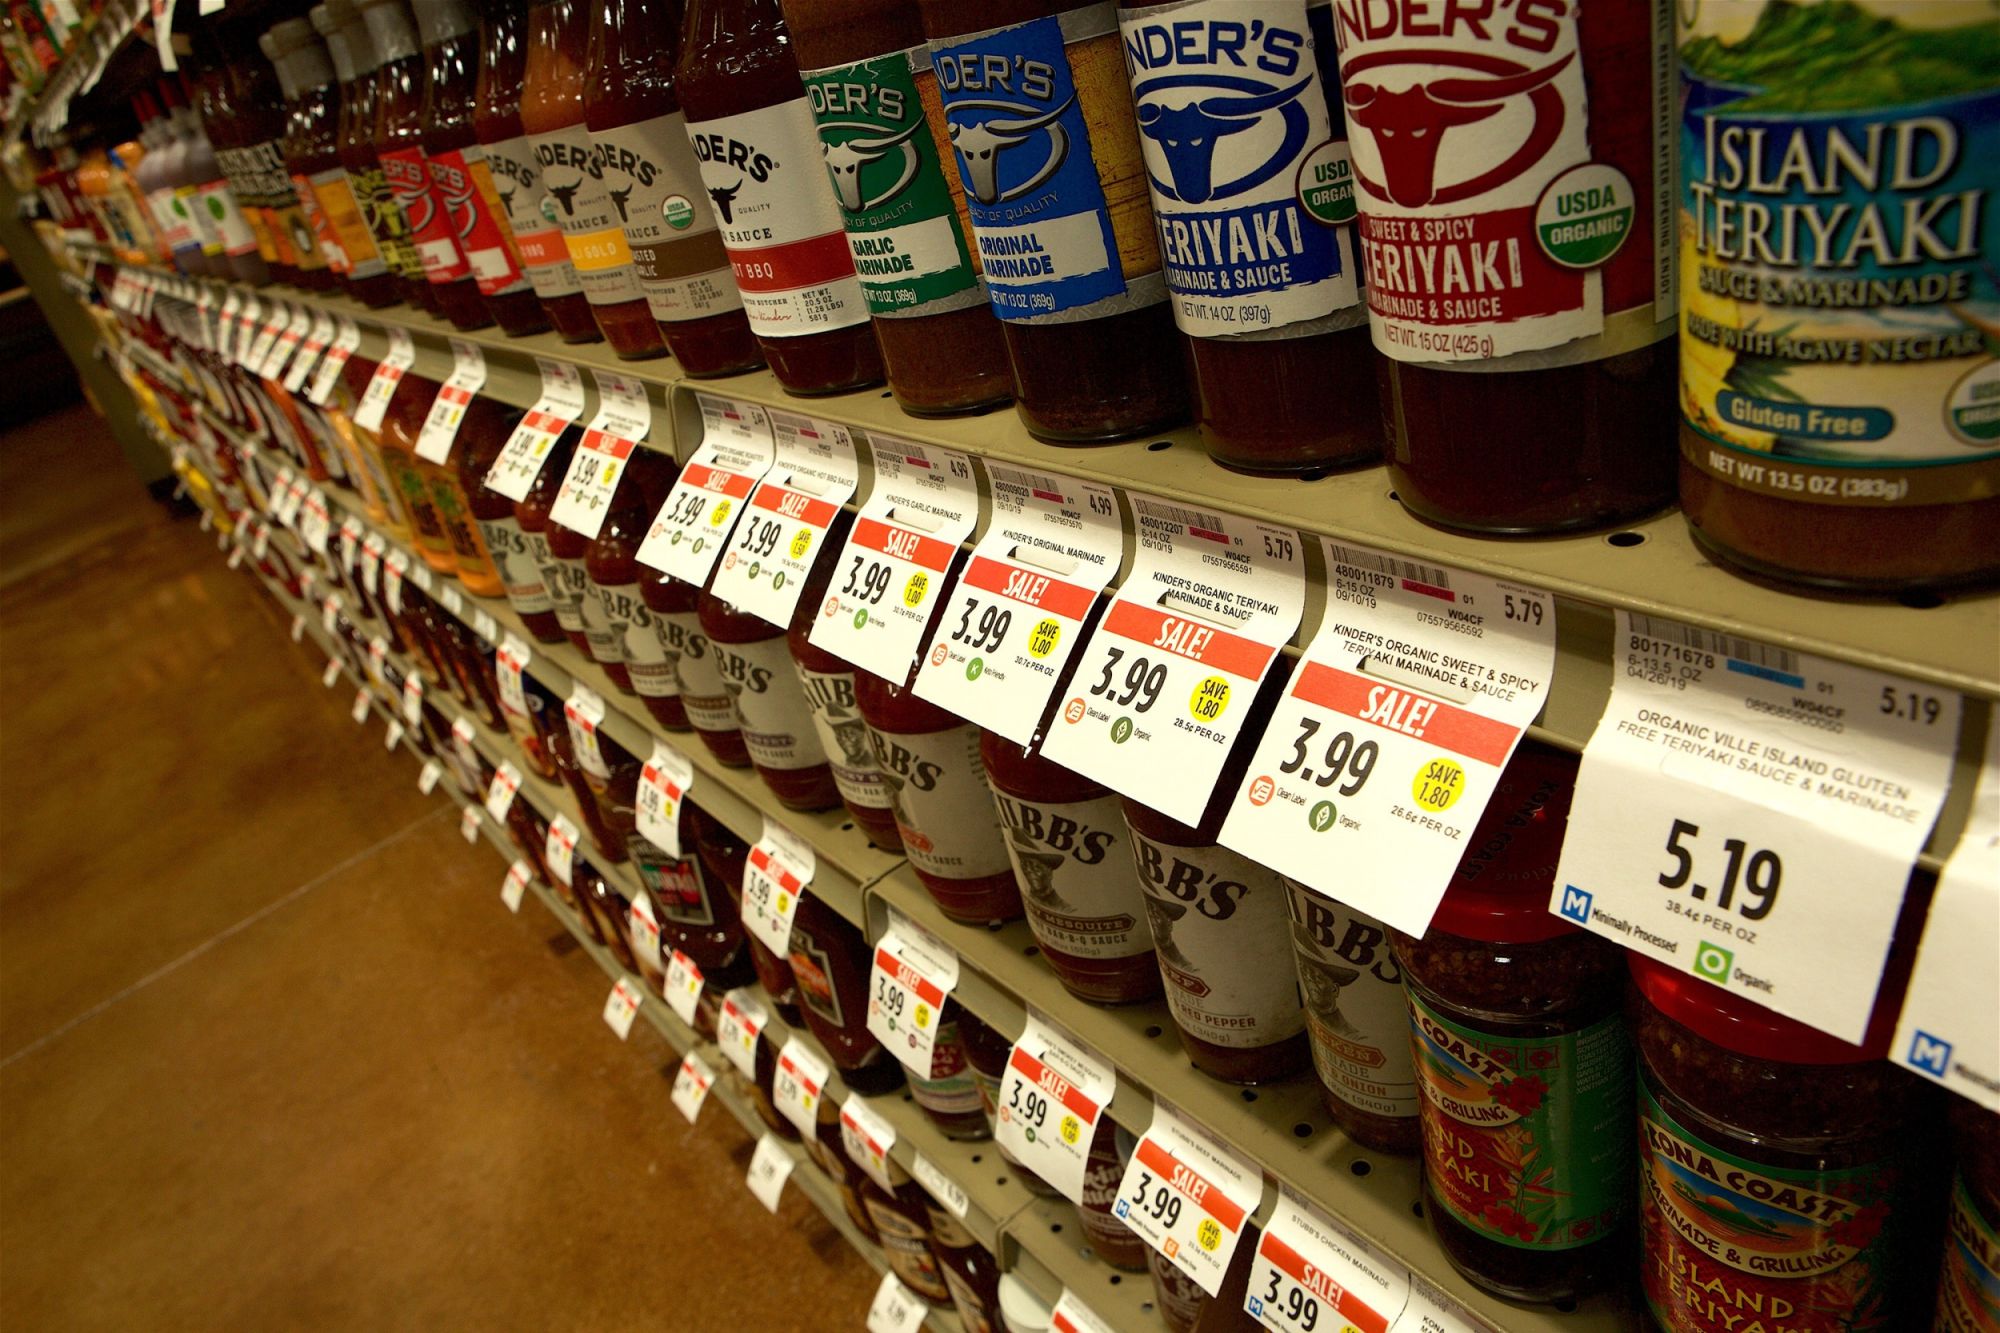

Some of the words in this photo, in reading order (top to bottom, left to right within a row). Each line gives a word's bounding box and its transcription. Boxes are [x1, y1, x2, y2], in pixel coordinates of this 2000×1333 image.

[1334, 0, 1568, 56] NDER'S
[1124, 20, 1305, 78] NDER'S
[808, 83, 905, 121] DER'S
[1703, 114, 1959, 195] ISLAND
[870, 201, 915, 227] QUALITY
[1006, 191, 1060, 222] QUALITY
[1556, 184, 1617, 216] USDA
[729, 228, 774, 243] SAUCE
[1369, 219, 1407, 242] SWEET
[1411, 220, 1420, 241] &
[1424, 218, 1474, 241] SPICY
[1551, 214, 1625, 246] ORGANIC
[1690, 182, 1987, 270] TERIYAKI
[853, 237, 896, 257] GARLIC
[980, 234, 1044, 256] ORIGINAL
[747, 262, 775, 280] BBQ
[983, 256, 1055, 279] MARINADE
[1221, 271, 1231, 290] &
[1236, 263, 1292, 288] SAUCE
[1361, 237, 1523, 295] TERIYAKI
[1699, 261, 1759, 302] SAUCE
[1786, 270, 1972, 308] MARINADE
[1239, 304, 1272, 324] (397g)
[1371, 297, 1425, 320] MARINADE
[1429, 300, 1439, 319] &
[1443, 296, 1503, 319] SAUCE
[1430, 333, 1451, 352] OZ
[1722, 323, 1774, 357] WITH
[1776, 331, 1860, 363] AGAVE
[1866, 329, 1986, 363] NECTAR
[1730, 396, 1801, 432] Gluten
[1807, 409, 1869, 437] Free
[703, 471, 731, 493] SALE!
[1709, 450, 1737, 477] NET
[1737, 462, 1766, 485] WT
[1769, 469, 1804, 492] 13.5
[1808, 474, 1838, 497] OZ
[1842, 476, 1908, 501] (383g)
[667, 492, 707, 528] 3.99
[776, 492, 810, 518] SALE!
[1089, 494, 1112, 518] 4.99
[740, 516, 782, 558] 3.99
[1140, 516, 1184, 536] 480012207
[883, 529, 921, 560] SALE!
[1002, 529, 1032, 546] KINDER'S
[1033, 538, 1065, 556] ORIGINAL
[1066, 547, 1106, 567] MARINADE
[1264, 535, 1293, 562] 5.79
[842, 555, 892, 605] 3.99
[910, 574, 928, 591] SAVE
[1002, 569, 1050, 605] SALE!
[1335, 563, 1394, 590] 480011879
[1359, 583, 1375, 598] OZ
[906, 588, 922, 605] 1.00
[1152, 570, 1192, 591] KINDER'S
[1193, 581, 1234, 604] ORGANIC
[1236, 593, 1279, 616] TERIYAKI
[1167, 588, 1214, 612] MARINADE
[1221, 604, 1254, 622] SAUCE
[1335, 592, 1378, 610] 09/10/19
[952, 597, 1012, 654] 3.99
[1416, 611, 1484, 639] 075579565592
[1448, 608, 1485, 626] W04CF
[1504, 595, 1544, 627] 5.79
[1031, 636, 1052, 656] 1.00
[1037, 621, 1059, 640] SAVE
[1154, 617, 1215, 661] SALE!
[1333, 622, 1384, 649] KINDER'S
[1385, 638, 1439, 666] ORGANIC
[1441, 655, 1484, 681] SWEET
[1488, 668, 1496, 681] &
[1500, 670, 1539, 694] SPICY
[1629, 636, 1715, 669] 80171678
[1090, 646, 1168, 713] 3.99
[1342, 640, 1395, 667] TERIYAKI
[1395, 657, 1460, 687] MARINADE
[1460, 676, 1469, 689] &
[1472, 679, 1516, 703] SAUCE
[1627, 668, 1687, 691] 04/26/19
[1628, 654, 1673, 675] 6-13.5
[1679, 666, 1702, 684] OZ
[1201, 679, 1229, 701] SAVE
[1195, 696, 1220, 719] 1.80
[1359, 685, 1439, 739] SALE!
[1879, 687, 1941, 727] 5.19
[1173, 717, 1194, 732] 28.5¢
[1194, 725, 1212, 740] PER
[1279, 717, 1379, 798] 3.99
[1637, 709, 1709, 741] ORGANIC
[1713, 730, 1760, 756] VILLE
[1761, 743, 1830, 777] ISLAND
[1831, 766, 1911, 802] GLUTEN
[1425, 761, 1461, 789] SAVE
[1617, 720, 1659, 746] FREE
[1661, 732, 1735, 769] TERIYAKI
[1736, 757, 1798, 787] SAUCE
[1800, 776, 1812, 791] &
[1818, 781, 1920, 824] MARINADE
[1417, 780, 1450, 809] 1.80
[1391, 804, 1418, 825] 26.6¢
[1419, 816, 1443, 835] PER
[1444, 825, 1461, 841] OZ
[1658, 818, 1783, 921] 5.19
[1046, 914, 1124, 931] MESQUITE
[1591, 907, 1633, 938] Minimally
[1633, 924, 1677, 953] Processed
[1665, 898, 1701, 924] 38.4¢
[1702, 911, 1734, 935] PER
[1735, 925, 1757, 945] OZ
[1091, 933, 1128, 946] SAUCE
[878, 977, 905, 1017] 3.99
[1733, 967, 1776, 995] Organic
[1205, 1014, 1256, 1028] PEPPER
[1422, 1017, 1505, 1080] COAST
[1037, 1067, 1069, 1102] SALE!
[1342, 1075, 1387, 1096] ONION
[1009, 1079, 1047, 1127] 3.99
[1442, 1097, 1509, 1122] GRILLING
[1210, 1153, 1242, 1181] MARINADE
[1647, 1119, 1720, 1183] KONA
[1726, 1171, 1846, 1222] COAST
[1132, 1172, 1181, 1229] 3.99
[1169, 1164, 1209, 1206] SALE!
[1203, 1222, 1221, 1238] SAVE
[1645, 1168, 1720, 1255] MARINADE
[1726, 1248, 1741, 1265] &
[1748, 1246, 1845, 1274] GRILLING
[1199, 1233, 1215, 1251] 1.00
[1291, 1214, 1320, 1239] STUBB'S
[1320, 1235, 1352, 1262] CHICKEN
[1351, 1256, 1390, 1290] MARINADE
[1301, 1264, 1343, 1310] SALE!
[1667, 1243, 1795, 1320] ISLAND
[1264, 1269, 1318, 1333] 3.99
